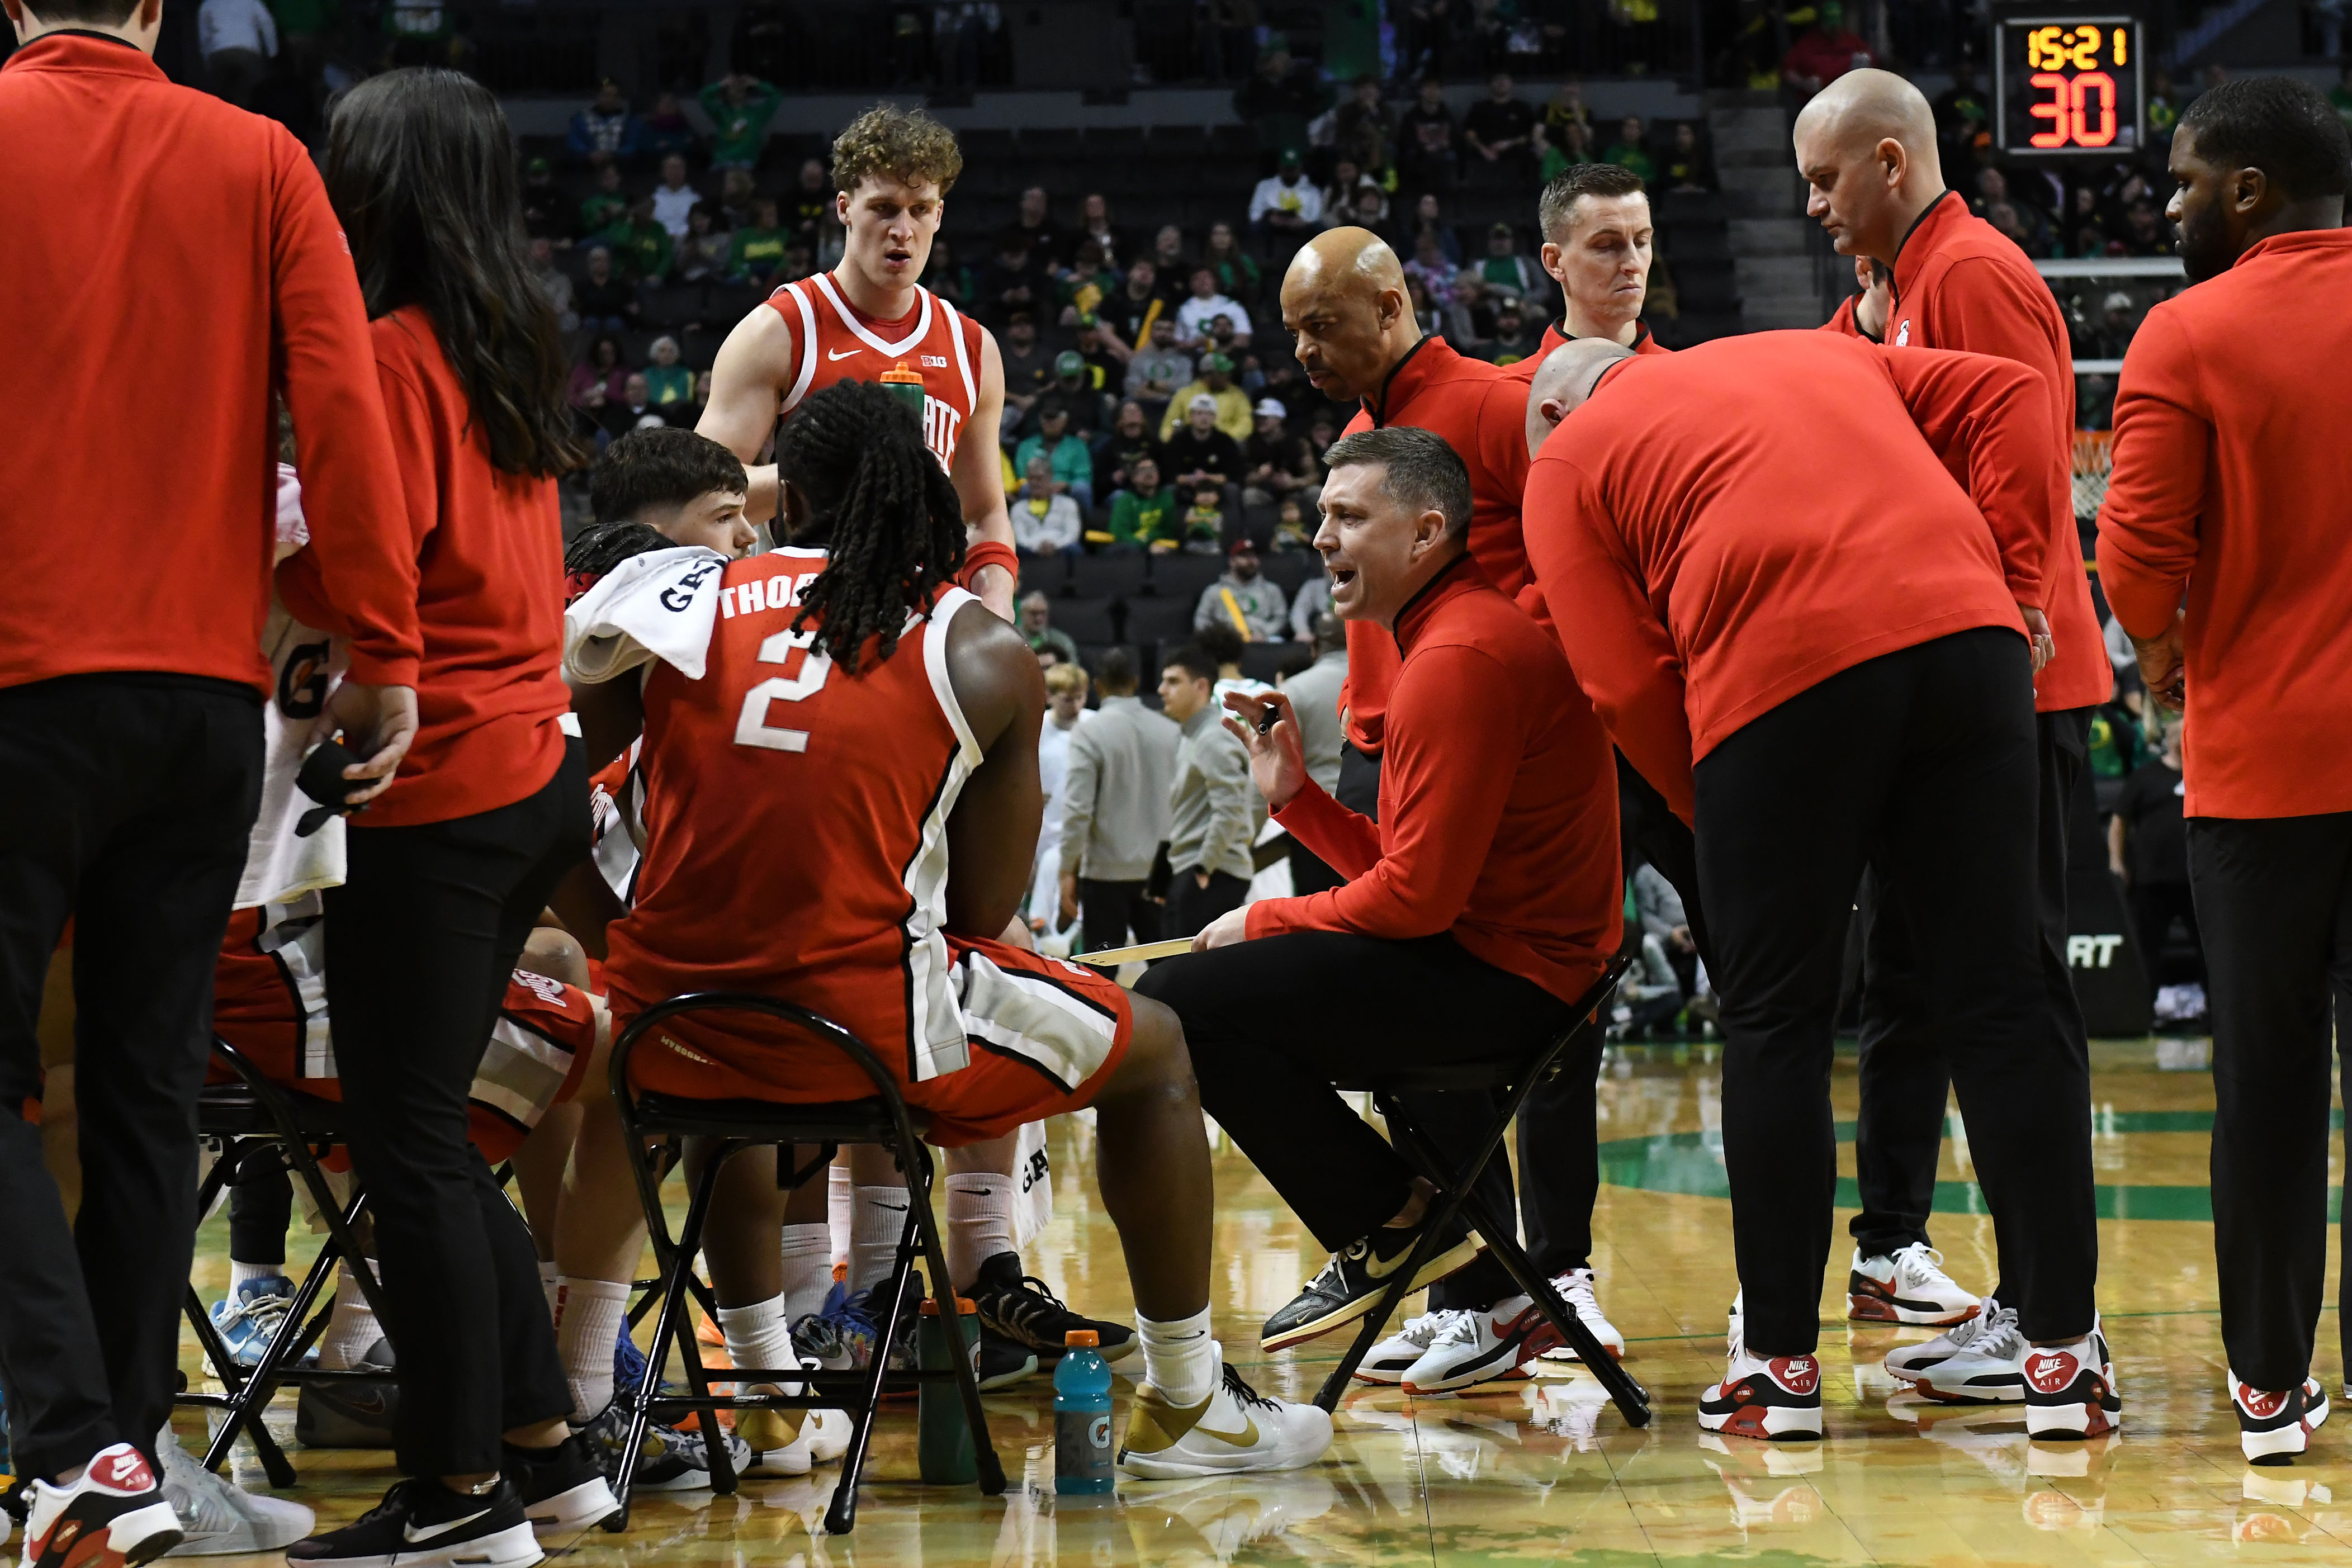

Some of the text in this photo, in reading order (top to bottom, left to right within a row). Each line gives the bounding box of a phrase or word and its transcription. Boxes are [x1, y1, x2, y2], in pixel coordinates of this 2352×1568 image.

[2028, 26, 2128, 71] 15:21
[2029, 72, 2117, 148] 30
[923, 394, 962, 456] ATE
[733, 628, 833, 754] 2
[1789, 1360, 1809, 1371] NIKE
[2038, 1358, 2061, 1370] NIKE
[2040, 1377, 2061, 1386] AIR
[2254, 1401, 2274, 1411] AIR
[1088, 1415, 1110, 1449] G
